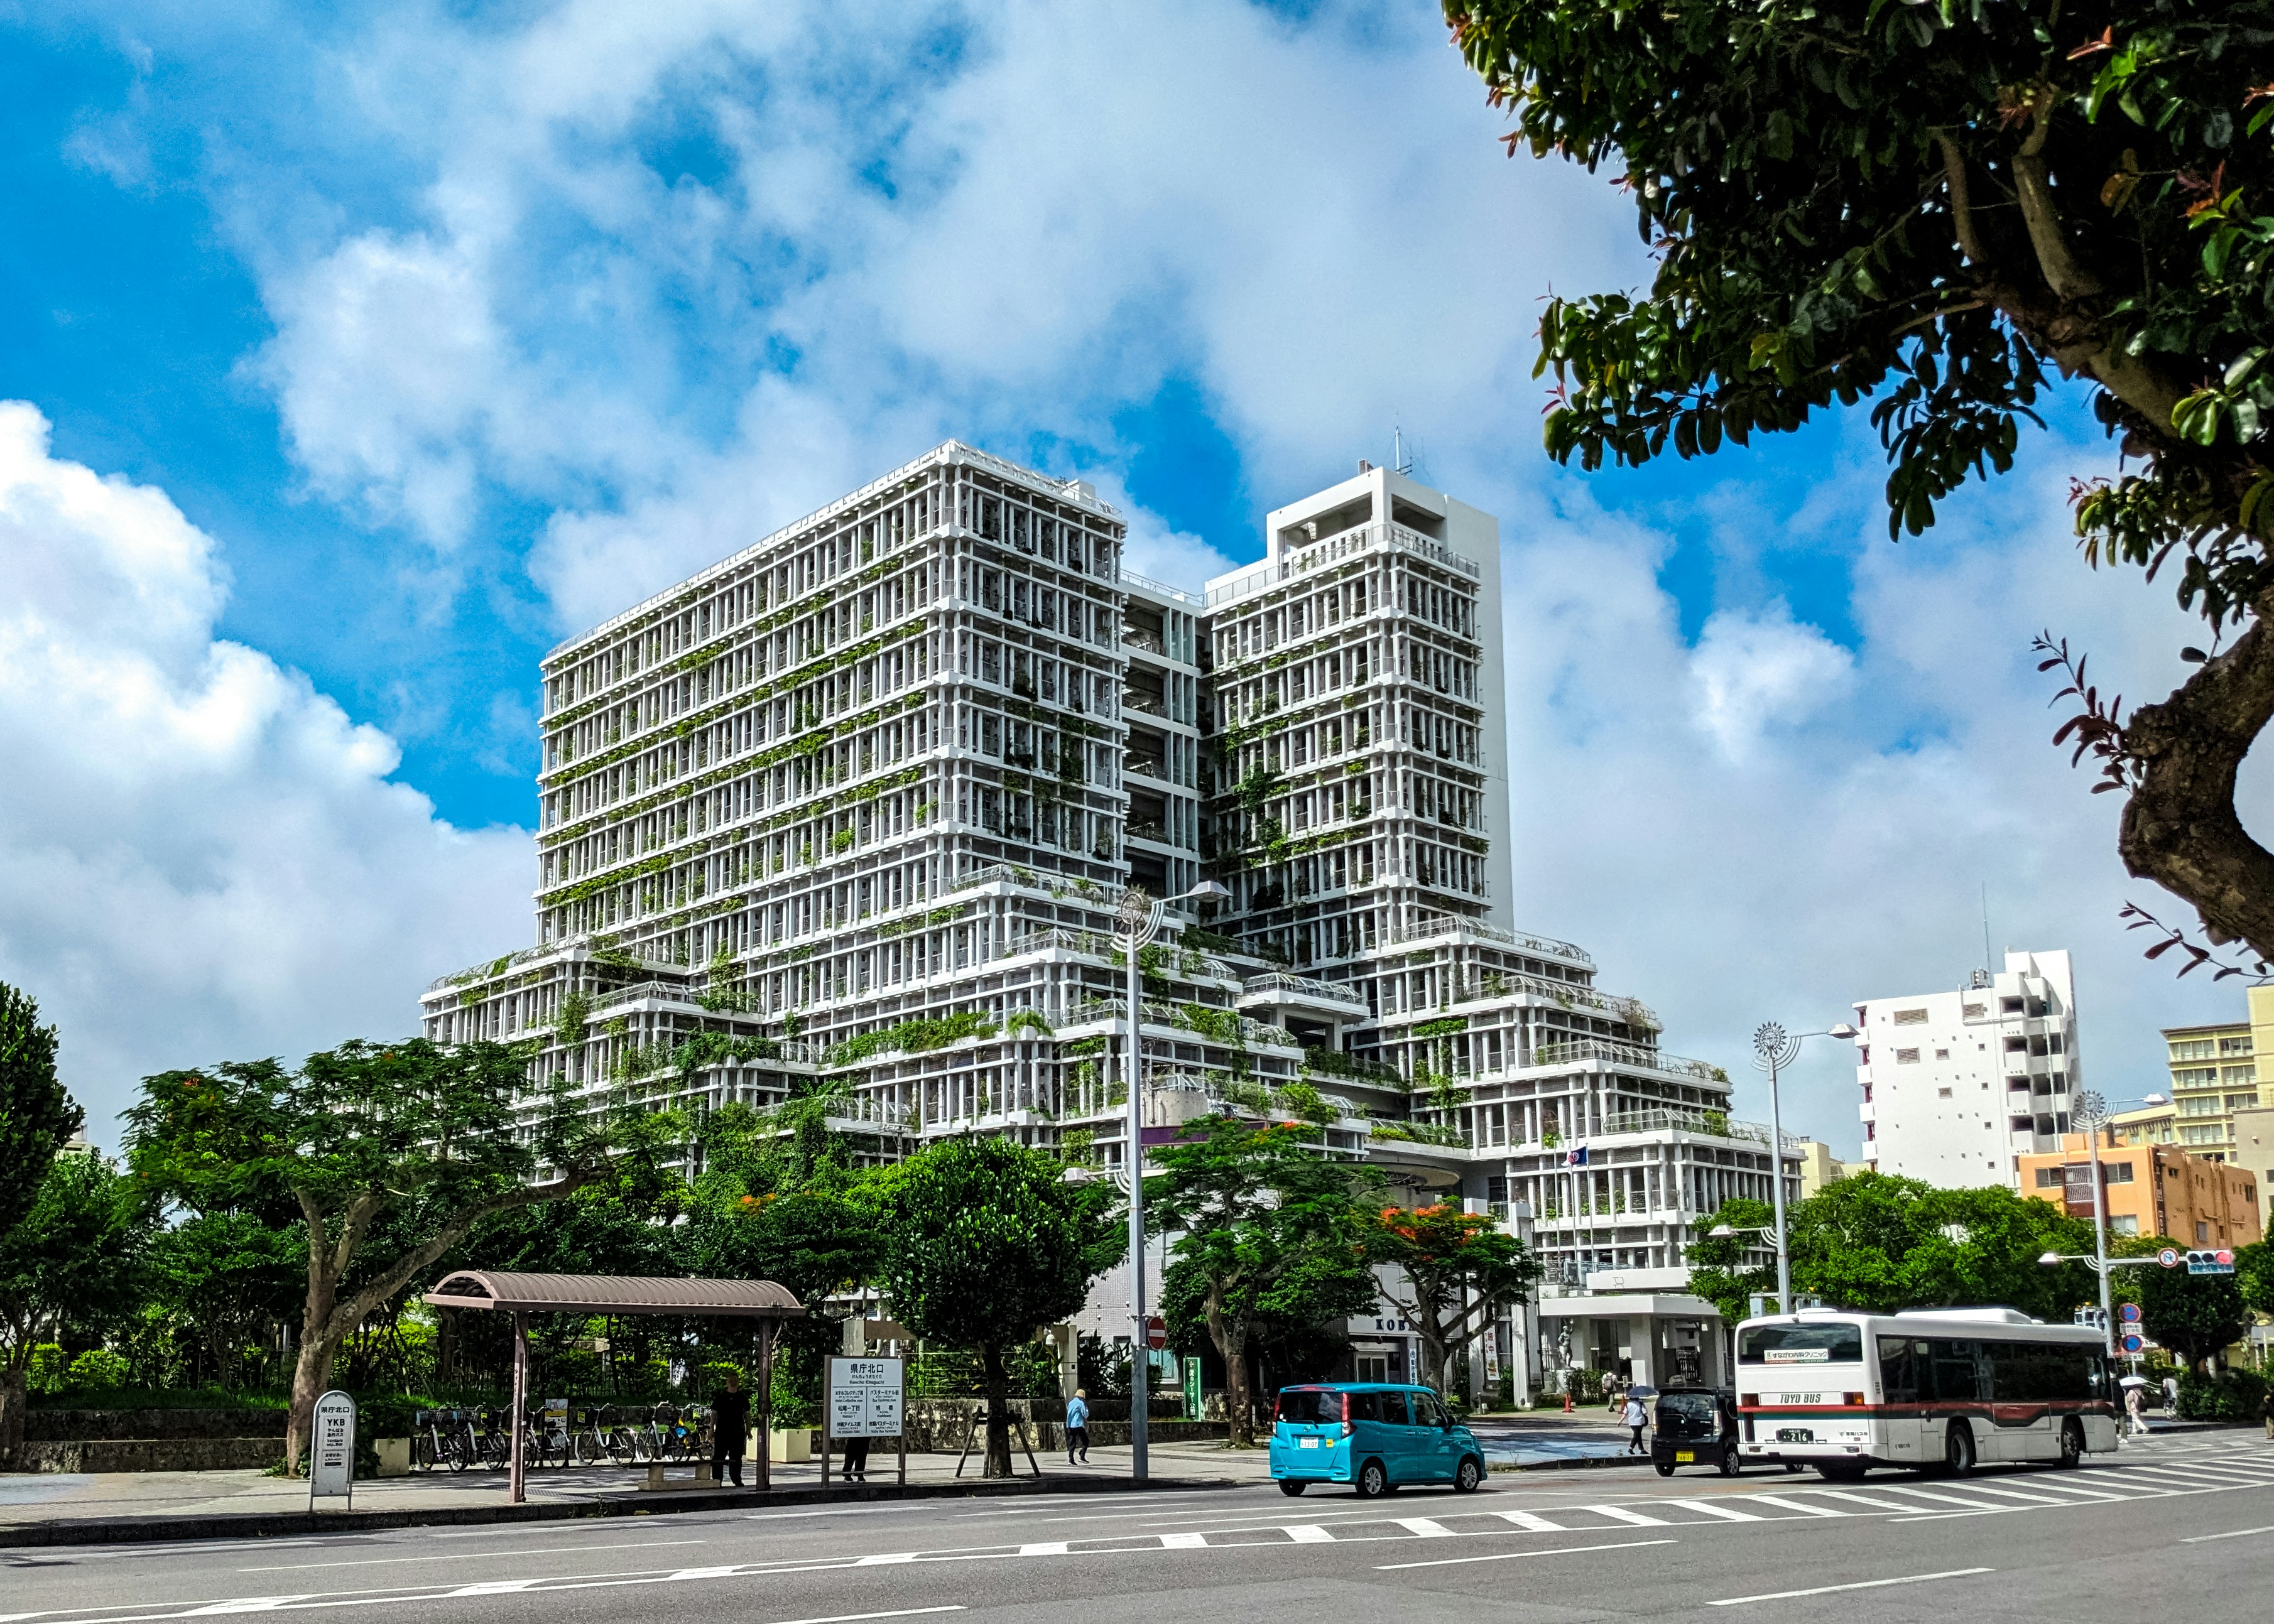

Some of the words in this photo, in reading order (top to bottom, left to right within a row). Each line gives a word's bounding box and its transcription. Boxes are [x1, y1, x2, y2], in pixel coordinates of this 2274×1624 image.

[851, 1363, 884, 1373] 県庁北口
[1780, 1394, 1800, 1403] TOYO
[1803, 1394, 1821, 1403] BUS
[1791, 1433, 1807, 1441] 216
